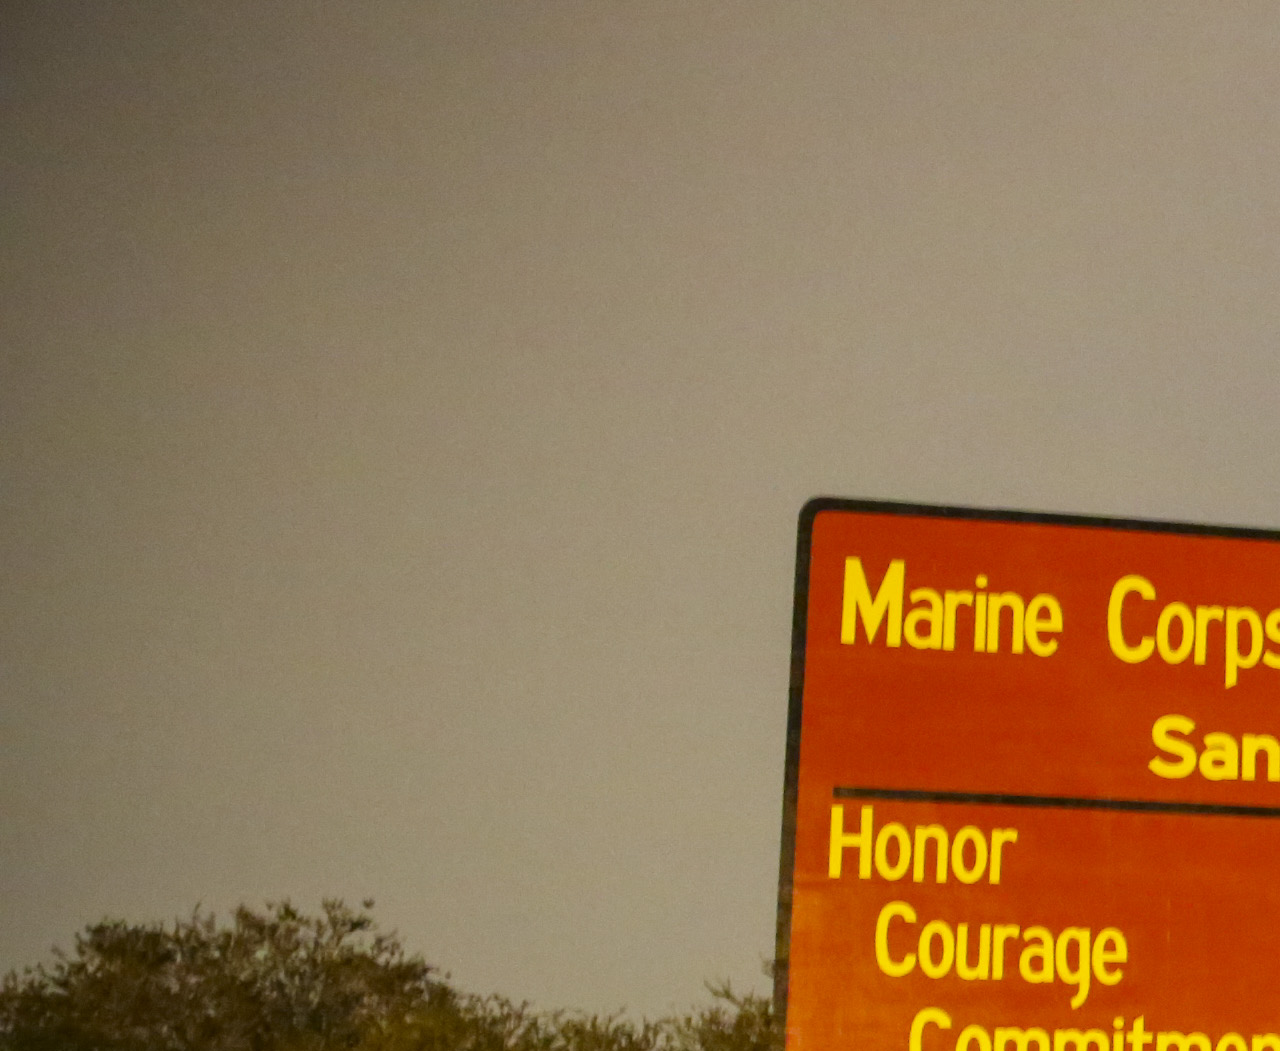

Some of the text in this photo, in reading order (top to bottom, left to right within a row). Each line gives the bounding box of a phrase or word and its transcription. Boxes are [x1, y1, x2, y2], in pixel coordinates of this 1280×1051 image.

[839, 556, 1064, 658] Marine
[827, 804, 1018, 885] Honor
[873, 901, 1129, 1010] Courage
